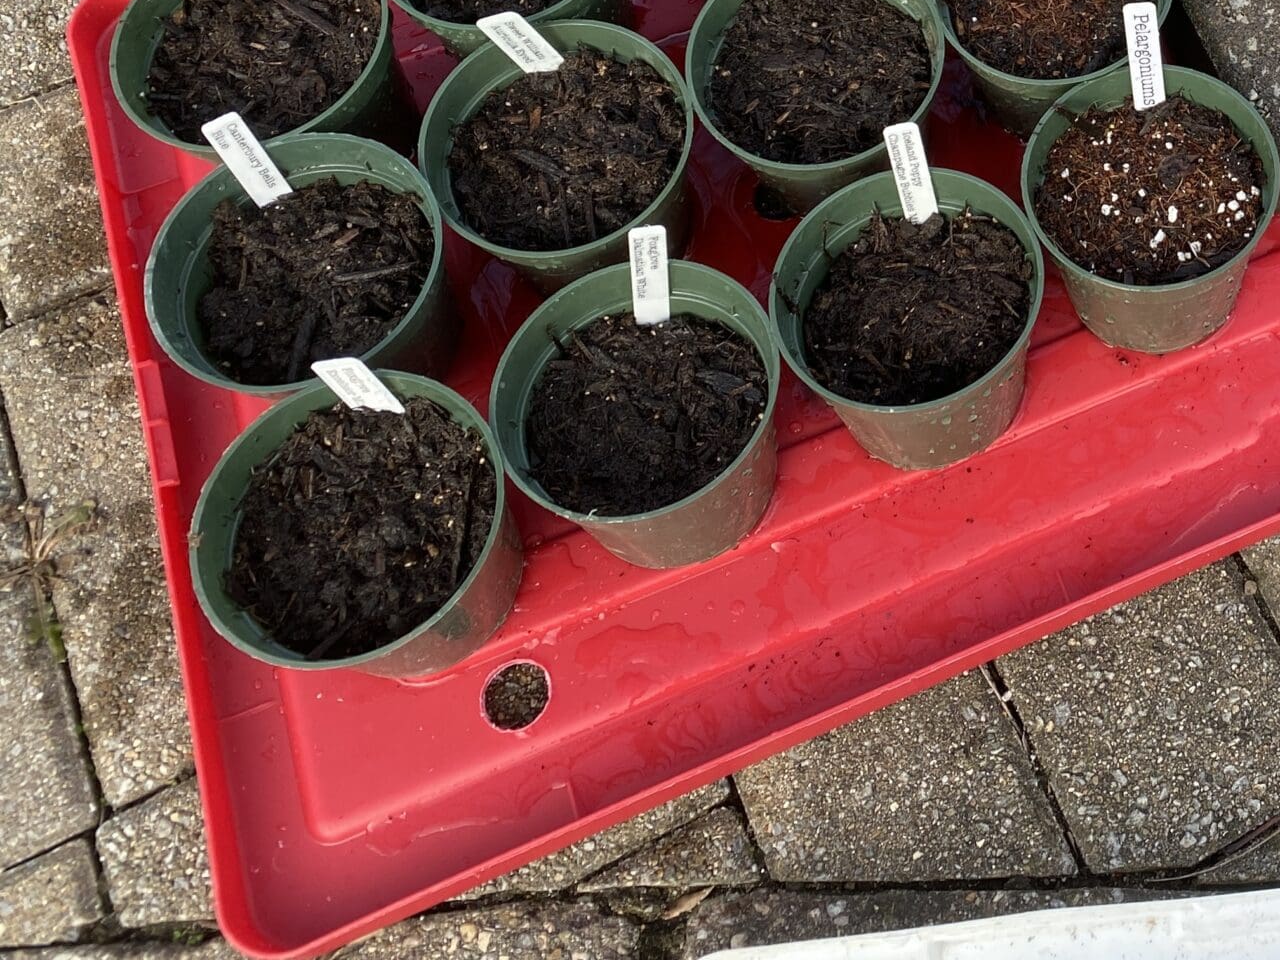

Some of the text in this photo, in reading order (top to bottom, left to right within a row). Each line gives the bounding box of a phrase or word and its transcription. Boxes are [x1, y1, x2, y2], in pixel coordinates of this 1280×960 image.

[1134, 13, 1156, 106] Pelargoniums
[210, 129, 230, 151] Blue
[226, 122, 277, 189] Canterbury Bells
[902, 130, 923, 186] Iceland Poppy
[888, 133, 907, 180] Champagne
[900, 181, 917, 212] Bubbles
[647, 236, 660, 269] Foxglove
